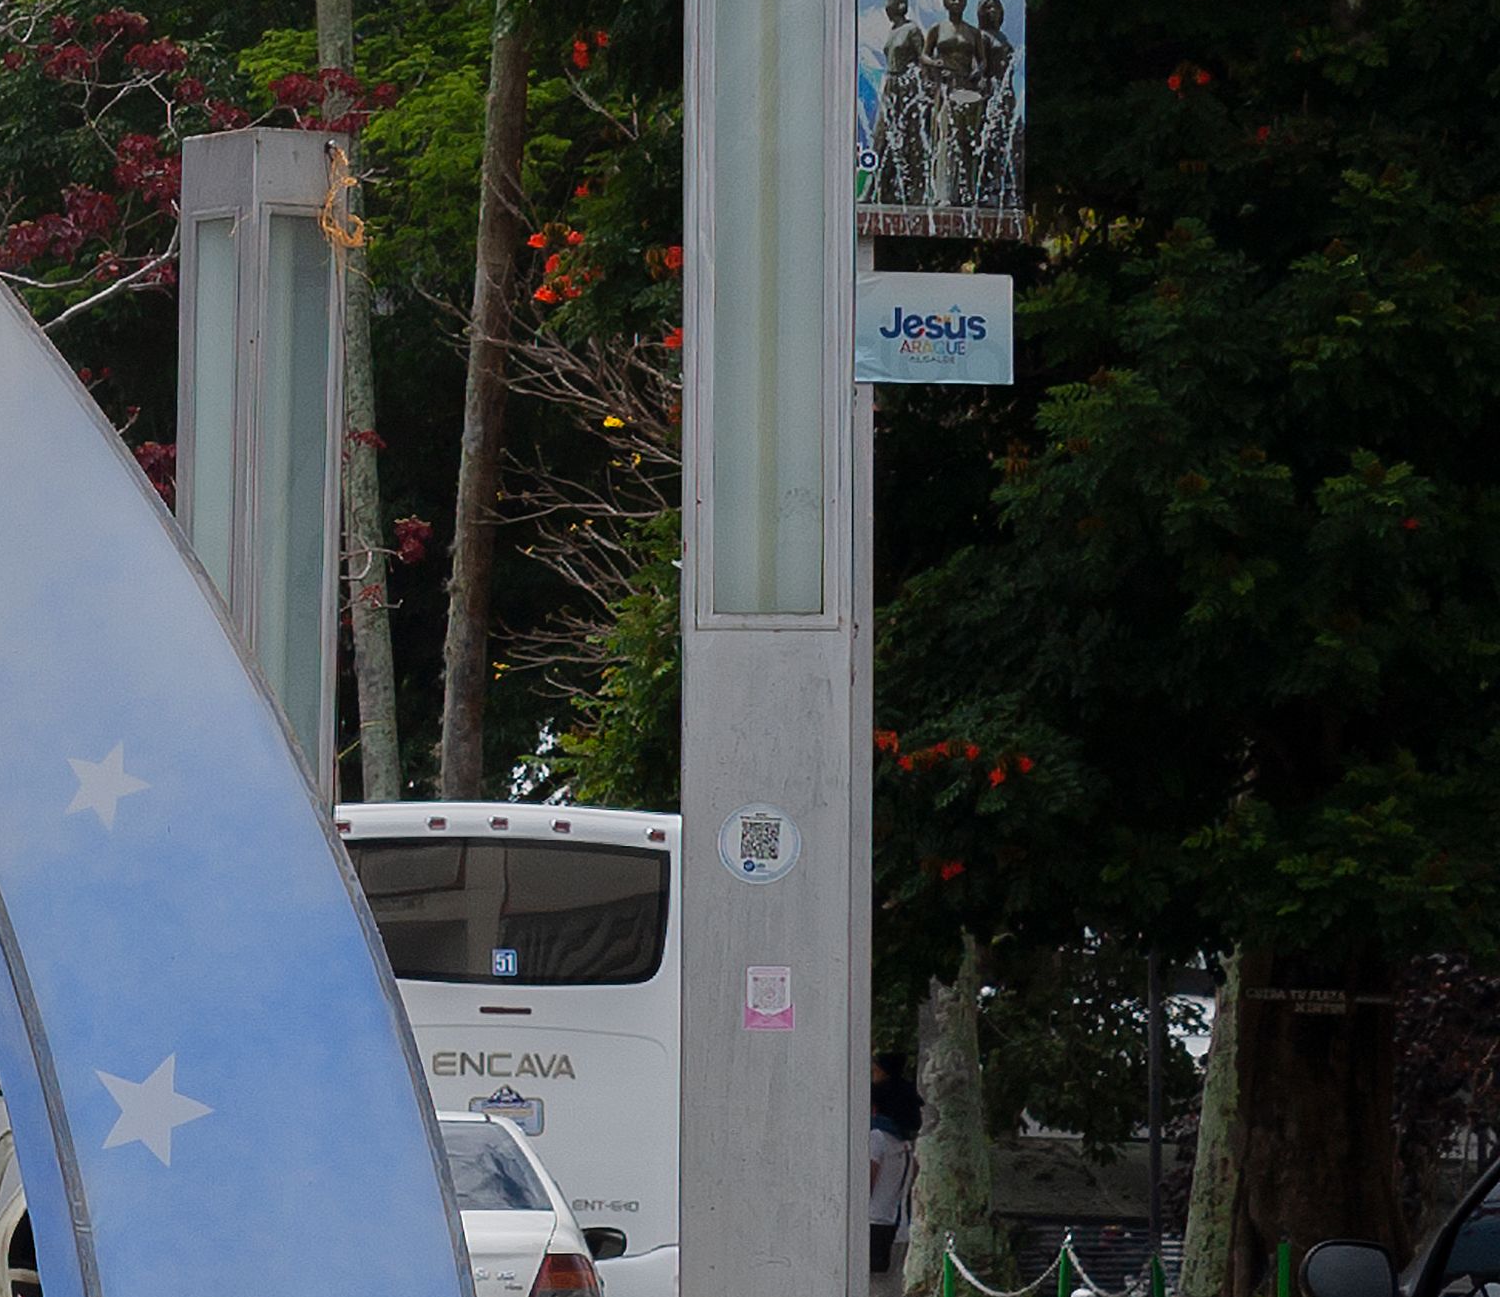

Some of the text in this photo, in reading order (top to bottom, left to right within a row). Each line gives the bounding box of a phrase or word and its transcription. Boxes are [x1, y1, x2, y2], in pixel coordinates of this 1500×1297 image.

[900, 340, 965, 355] ARAQUE
[496, 953, 514, 972] 51
[432, 1052, 576, 1079] ENCAVA
